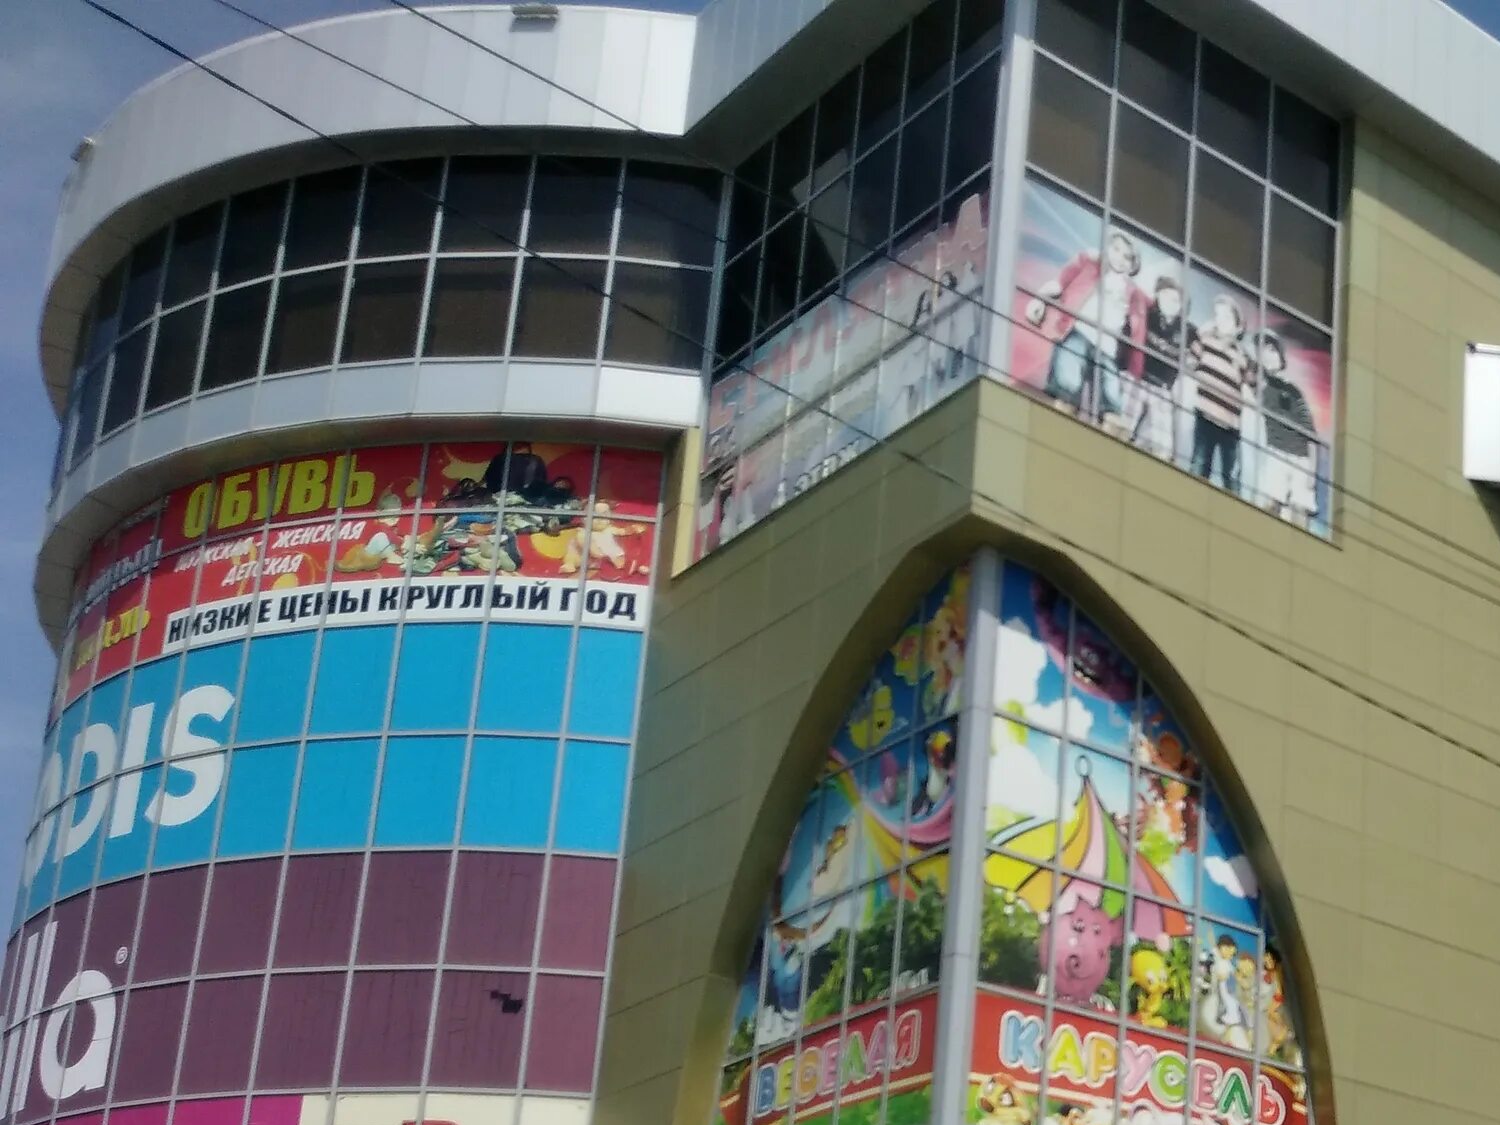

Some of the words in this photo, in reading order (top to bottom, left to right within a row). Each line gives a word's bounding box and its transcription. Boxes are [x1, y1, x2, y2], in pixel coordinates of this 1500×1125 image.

[184, 454, 376, 539] ОБУВЬ
[221, 553, 304, 587] ДЕТСКАЯ
[273, 521, 366, 550] ЖЕНСКАЯ
[168, 598, 272, 644] НИЗКИЕ
[279, 587, 369, 624] ЦЕНЫ
[378, 580, 551, 612] КРУГЛЫЙ
[560, 586, 637, 621] ГОД
[0, 920, 116, 1120] lla
[753, 1008, 922, 1117] ВЕСЕЛАЯ
